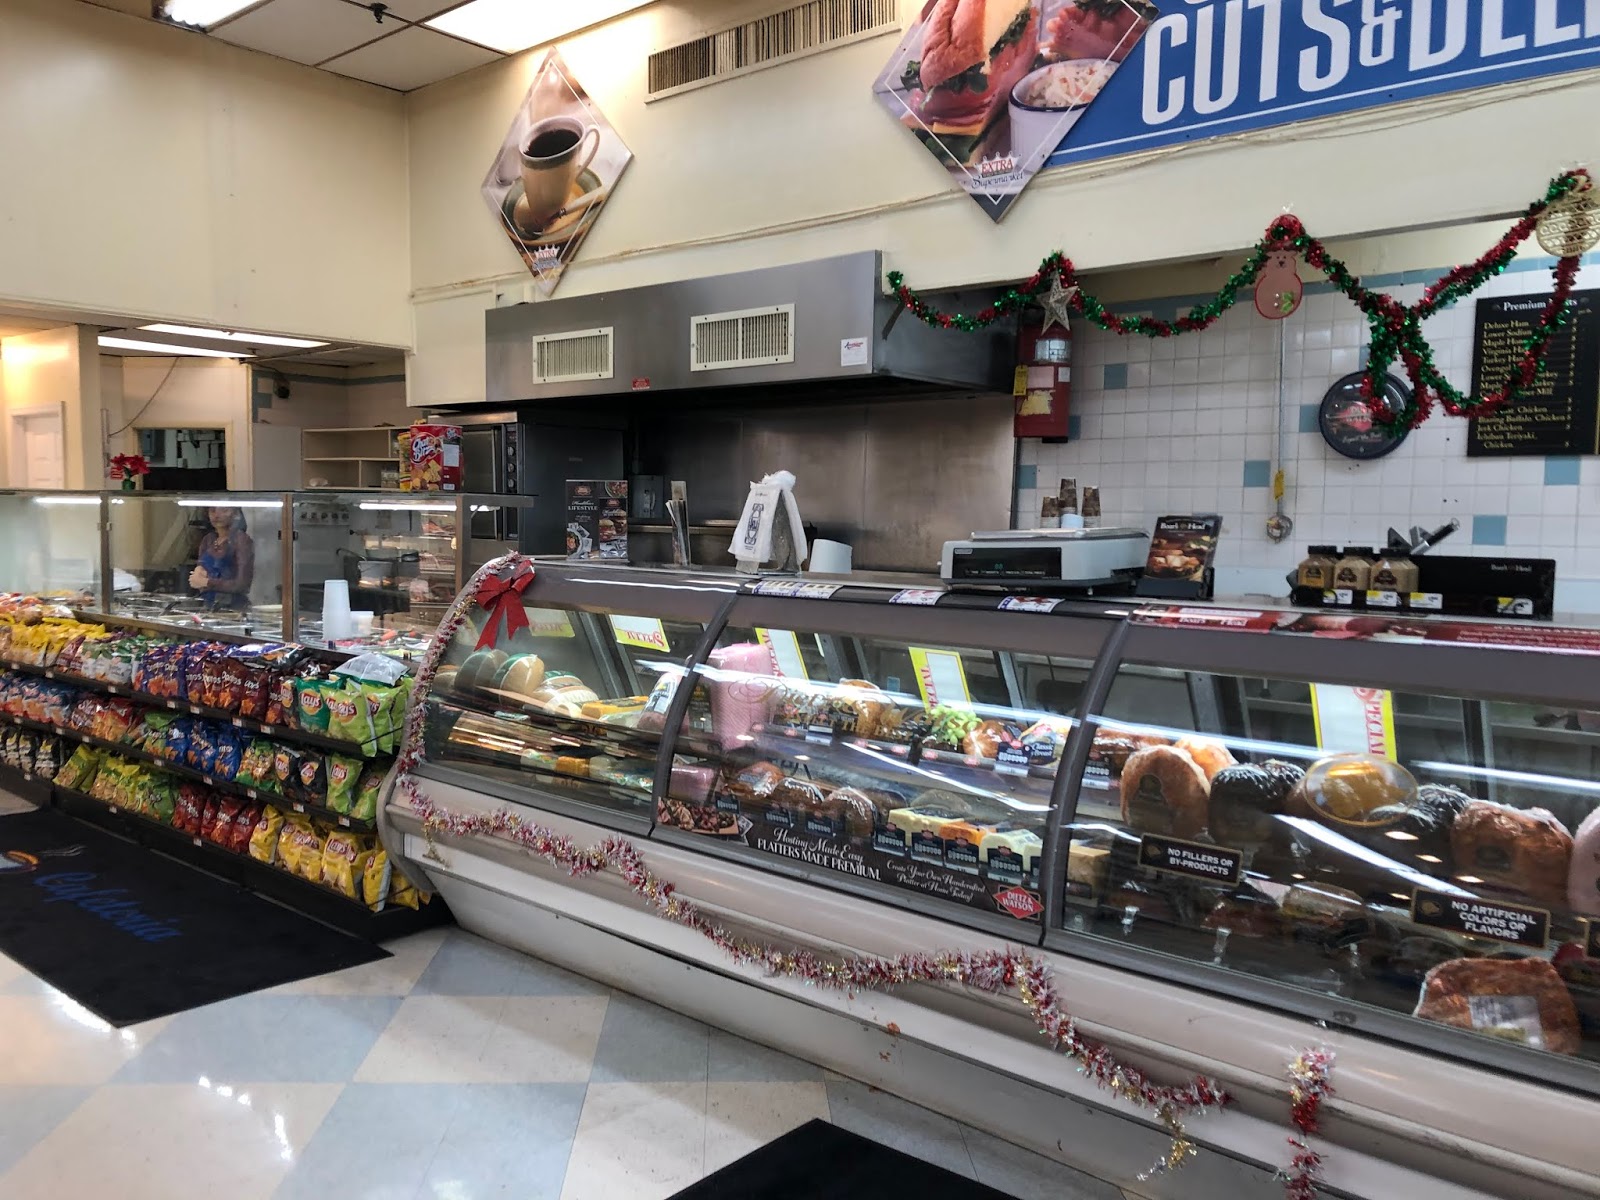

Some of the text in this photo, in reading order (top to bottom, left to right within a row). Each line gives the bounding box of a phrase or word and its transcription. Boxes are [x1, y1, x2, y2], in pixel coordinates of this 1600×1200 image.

[1142, 0, 1351, 125] CUTS
[981, 158, 1014, 174] EXTRA
[1503, 300, 1547, 312] Premium
[1483, 322, 1510, 330] Deluxe
[1511, 320, 1530, 328] Ham
[1482, 339, 1506, 348] Maple
[757, 838, 801, 859] PLATTERS
[801, 850, 830, 867] MADE
[773, 827, 863, 866] Hosting Made Easy
[1167, 847, 1234, 868] NO FILLERS OR
[1169, 857, 1229, 876] BY-PRODUCTS
[907, 864, 926, 879] Your
[926, 871, 942, 882] Own
[928, 882, 949, 895] Home
[1002, 898, 1034, 913] WATSON
[1451, 901, 1537, 925] NO ARTIFICIAL
[1459, 912, 1527, 932] COLORS OR
[1465, 922, 1520, 940] FLAVORS
